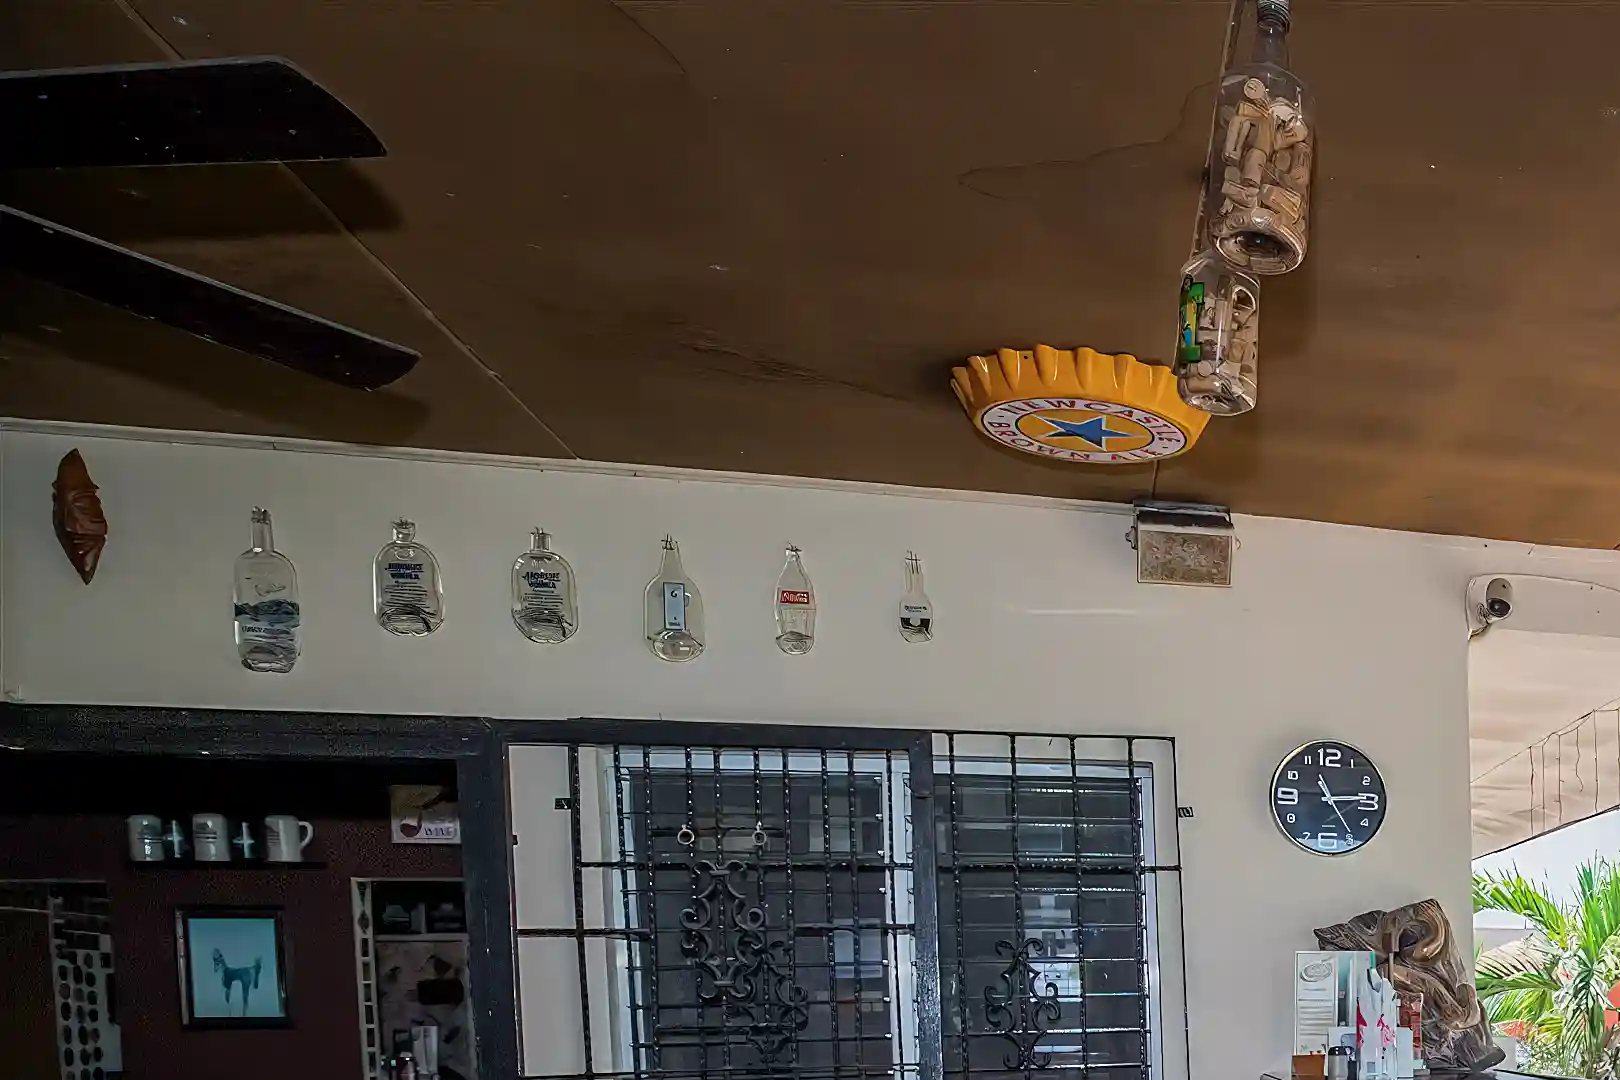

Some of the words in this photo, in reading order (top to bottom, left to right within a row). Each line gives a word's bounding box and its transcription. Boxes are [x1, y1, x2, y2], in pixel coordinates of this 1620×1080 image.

[999, 399, 1181, 444] NEWCASTLE
[987, 420, 1091, 461] BROWN
[1110, 448, 1164, 461] ALE
[1304, 755, 1312, 765] 11
[1317, 747, 1342, 768] 12
[1349, 758, 1354, 769] 1
[1361, 775, 1371, 786] 2
[1277, 787, 1299, 805] 9
[1357, 792, 1379, 811] 3
[1360, 817, 1369, 827] 4
[1302, 831, 1311, 841] 7
[1317, 832, 1338, 849] 6
